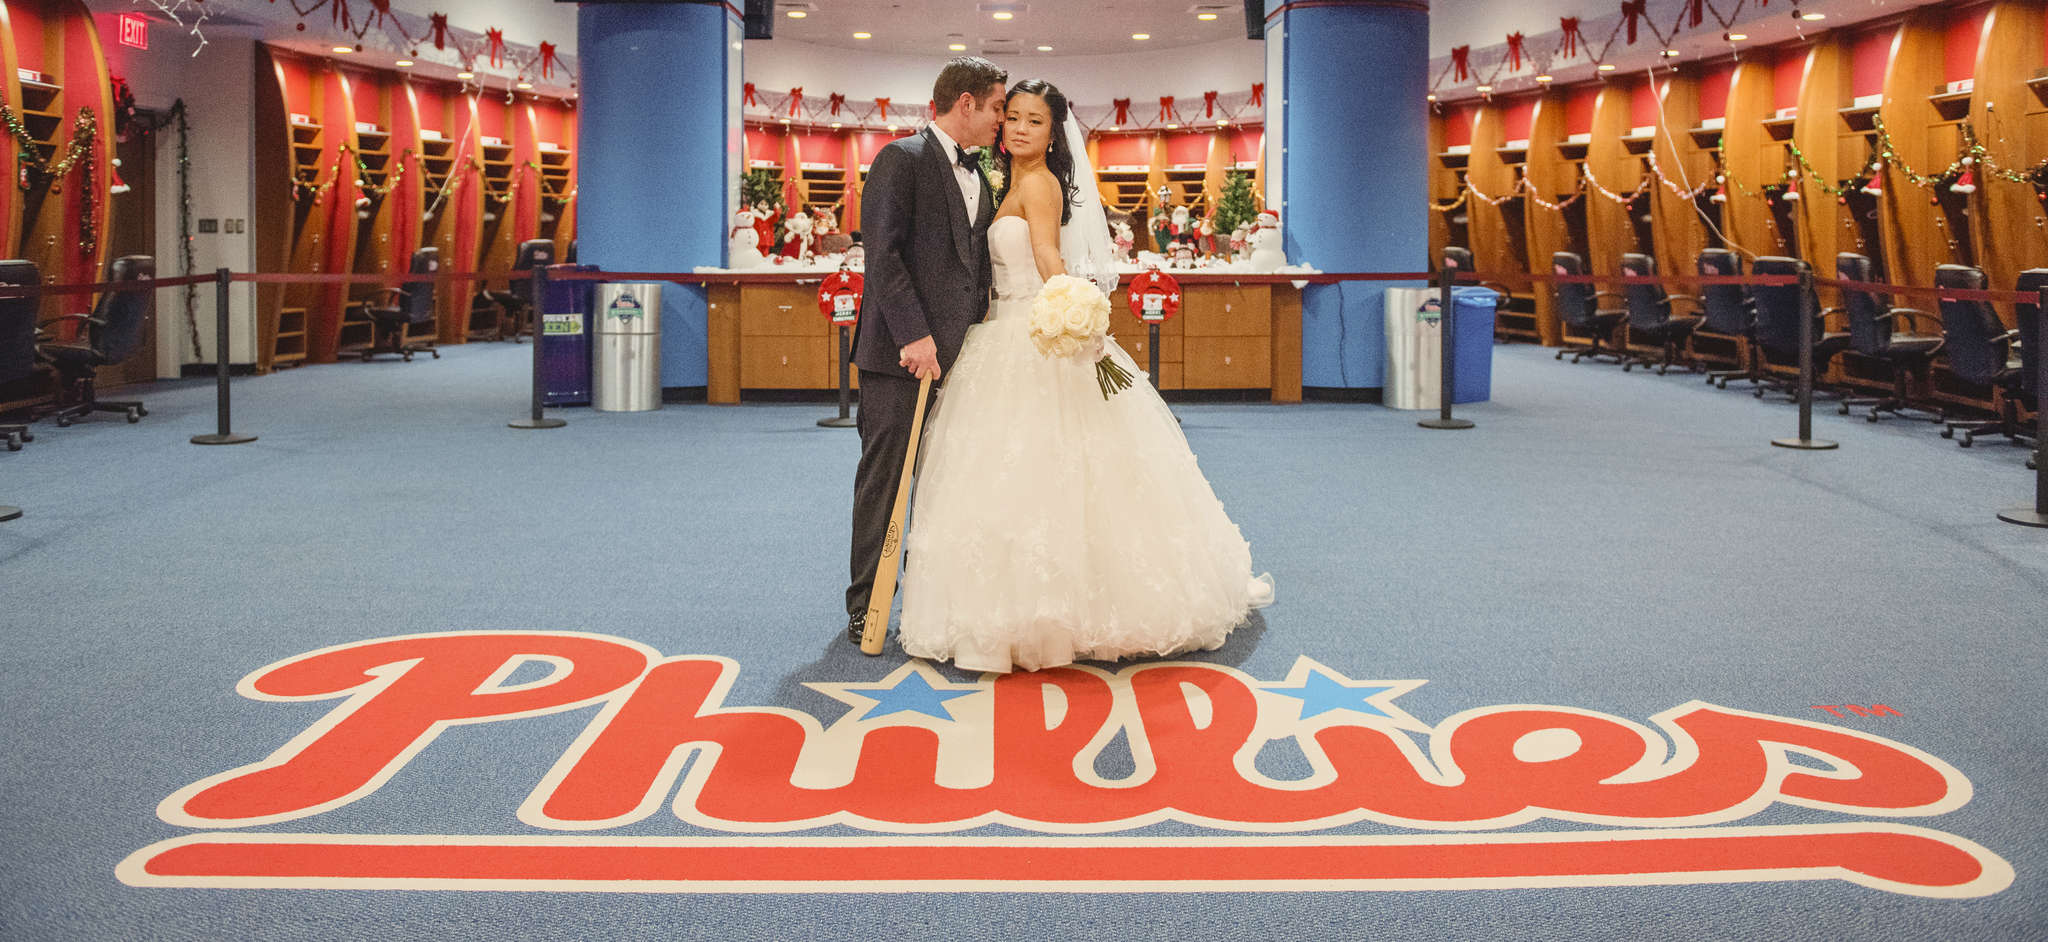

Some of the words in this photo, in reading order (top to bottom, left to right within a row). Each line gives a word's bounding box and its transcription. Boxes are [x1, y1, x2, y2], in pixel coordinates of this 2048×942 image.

[125, 18, 145, 45] EXIT
[1811, 704, 1904, 718] TM
[175, 632, 1955, 827] Phillies
